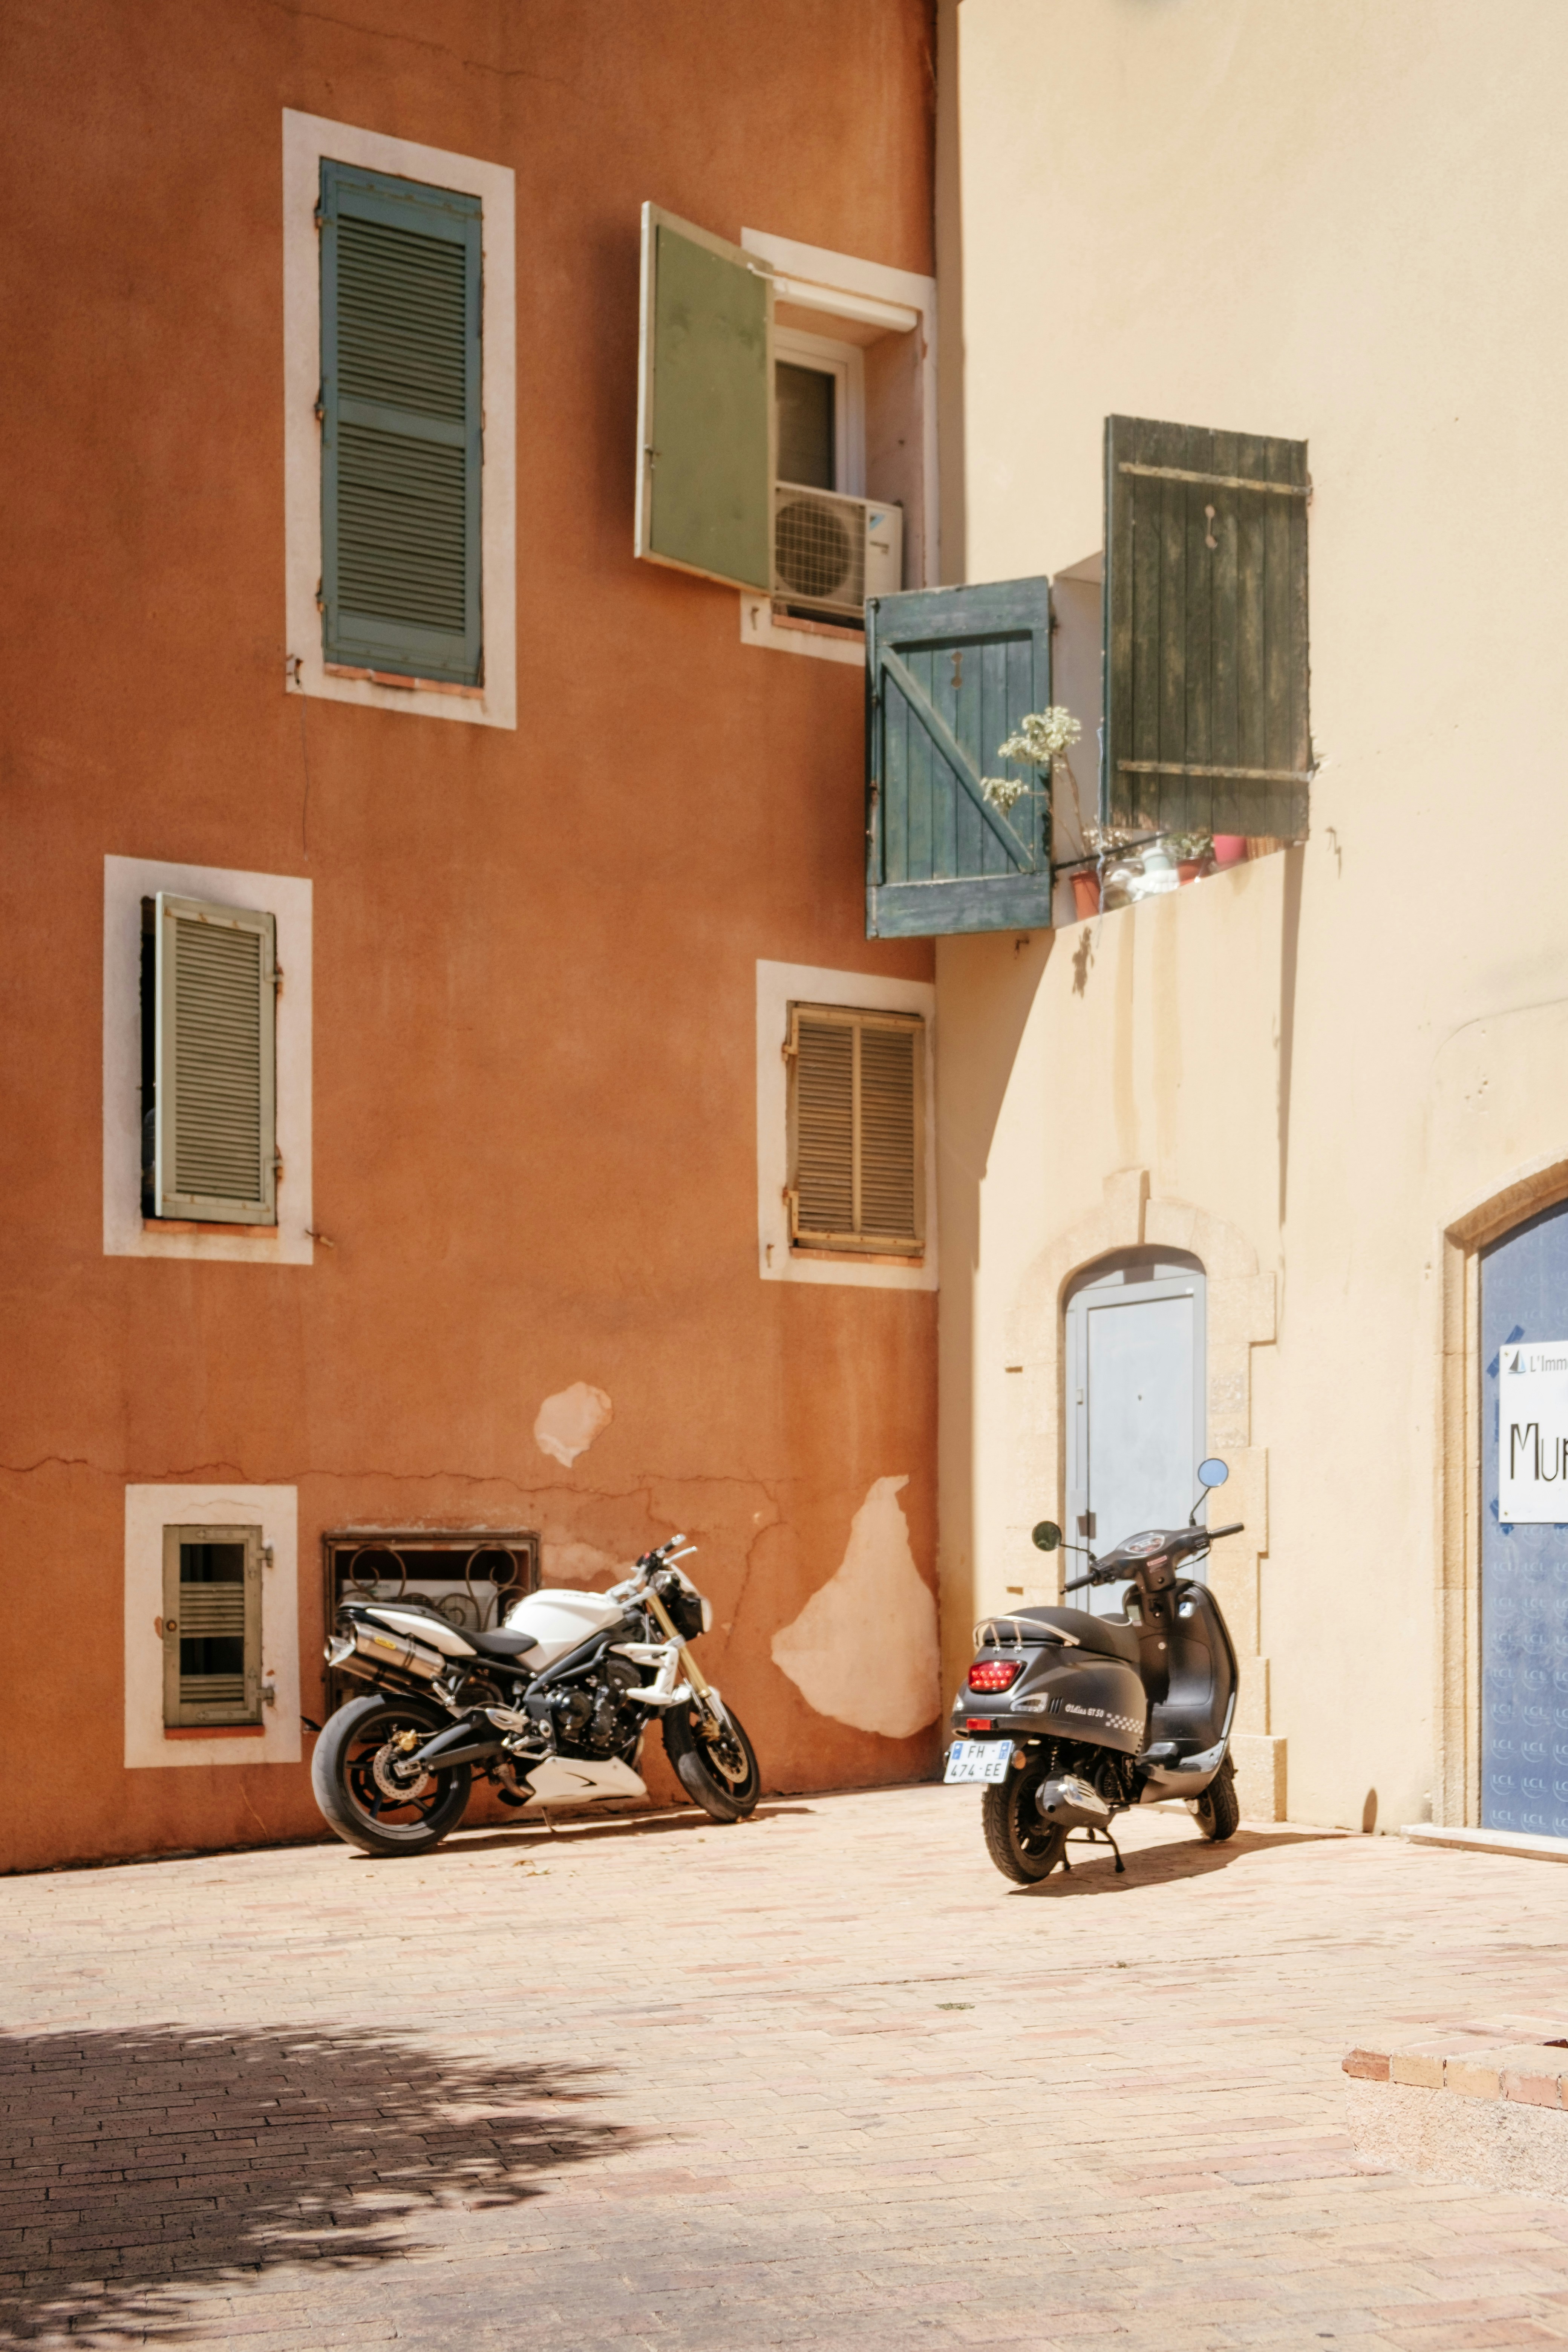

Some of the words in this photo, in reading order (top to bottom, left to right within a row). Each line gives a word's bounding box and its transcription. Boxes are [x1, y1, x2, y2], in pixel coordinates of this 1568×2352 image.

[1530, 1355, 1568, 1372] L'Imm
[1525, 1563, 1547, 1572] LCL
[1525, 1598, 1546, 1608] LCL
[1525, 1634, 1547, 1644] LCL
[1524, 1670, 1546, 1680] LCL
[1524, 1706, 1547, 1716] LCL
[1524, 1742, 1546, 1753] LCL
[1524, 1778, 1546, 1789] LCL
[1524, 1813, 1546, 1825] LCL
